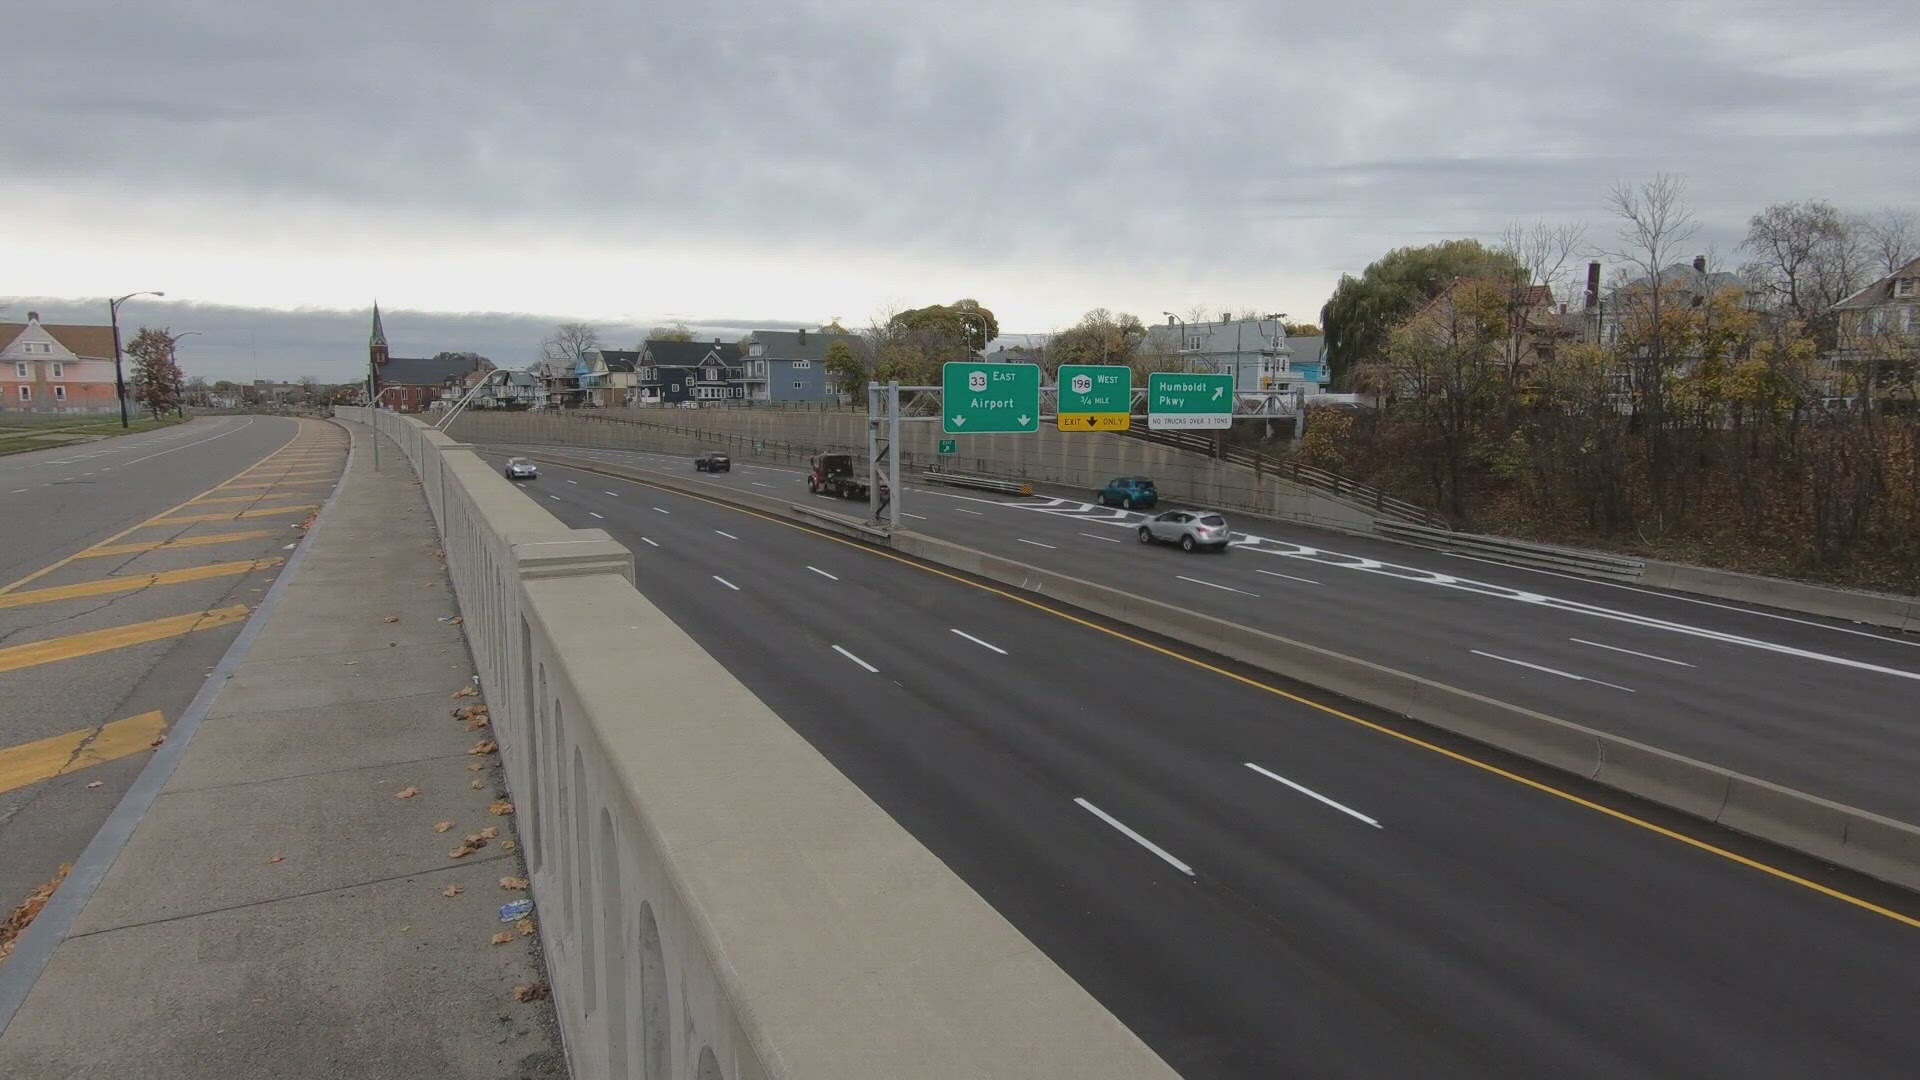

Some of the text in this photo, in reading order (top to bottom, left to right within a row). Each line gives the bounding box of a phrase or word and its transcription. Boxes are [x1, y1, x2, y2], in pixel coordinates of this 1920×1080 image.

[970, 376, 986, 387] 33
[1073, 379, 1091, 389] 198
[1159, 381, 1207, 392] Humboldt
[970, 398, 1014, 410] Airport
[1159, 395, 1185, 408] Pkwy
[1064, 417, 1123, 426] EXIT ONLY
